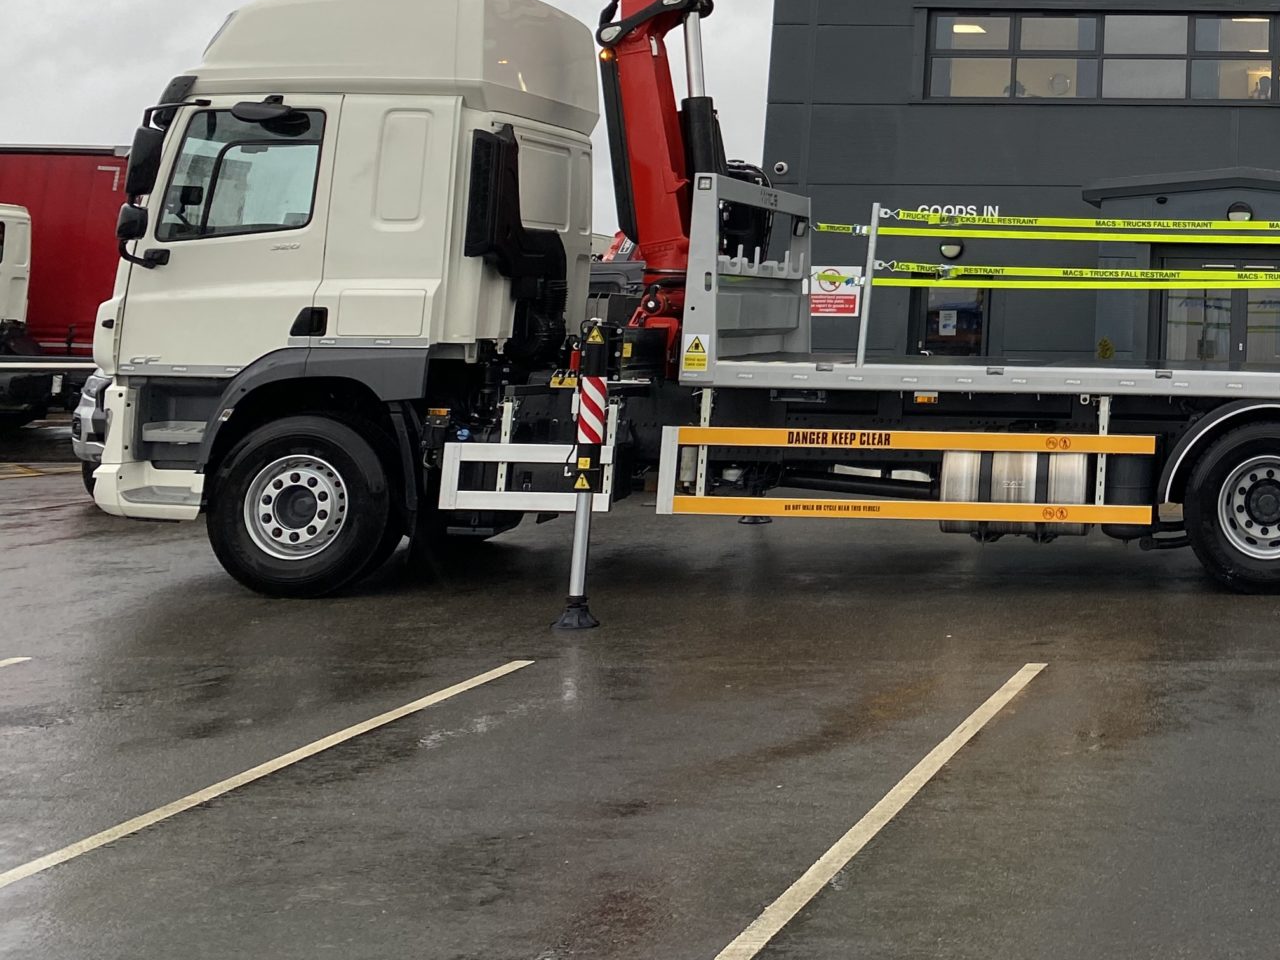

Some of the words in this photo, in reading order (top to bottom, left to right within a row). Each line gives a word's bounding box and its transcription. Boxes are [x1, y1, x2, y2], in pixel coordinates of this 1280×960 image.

[983, 205, 999, 218] IN
[977, 217, 996, 226] FALL
[998, 218, 1038, 226] RESTRAINT
[1172, 221, 1213, 229] RESTRAINT
[894, 263, 910, 271] ACS
[963, 267, 1005, 275] RESTRAINT
[1062, 269, 1084, 277] MACS
[1089, 270, 1119, 278] TRUCKS
[1120, 270, 1138, 278] FALL
[1140, 271, 1181, 279] RESTRAINT
[1237, 272, 1259, 280] MACS
[787, 430, 828, 445] DANGER
[831, 431, 856, 446] KEEP
[859, 431, 891, 447] CLEAR
